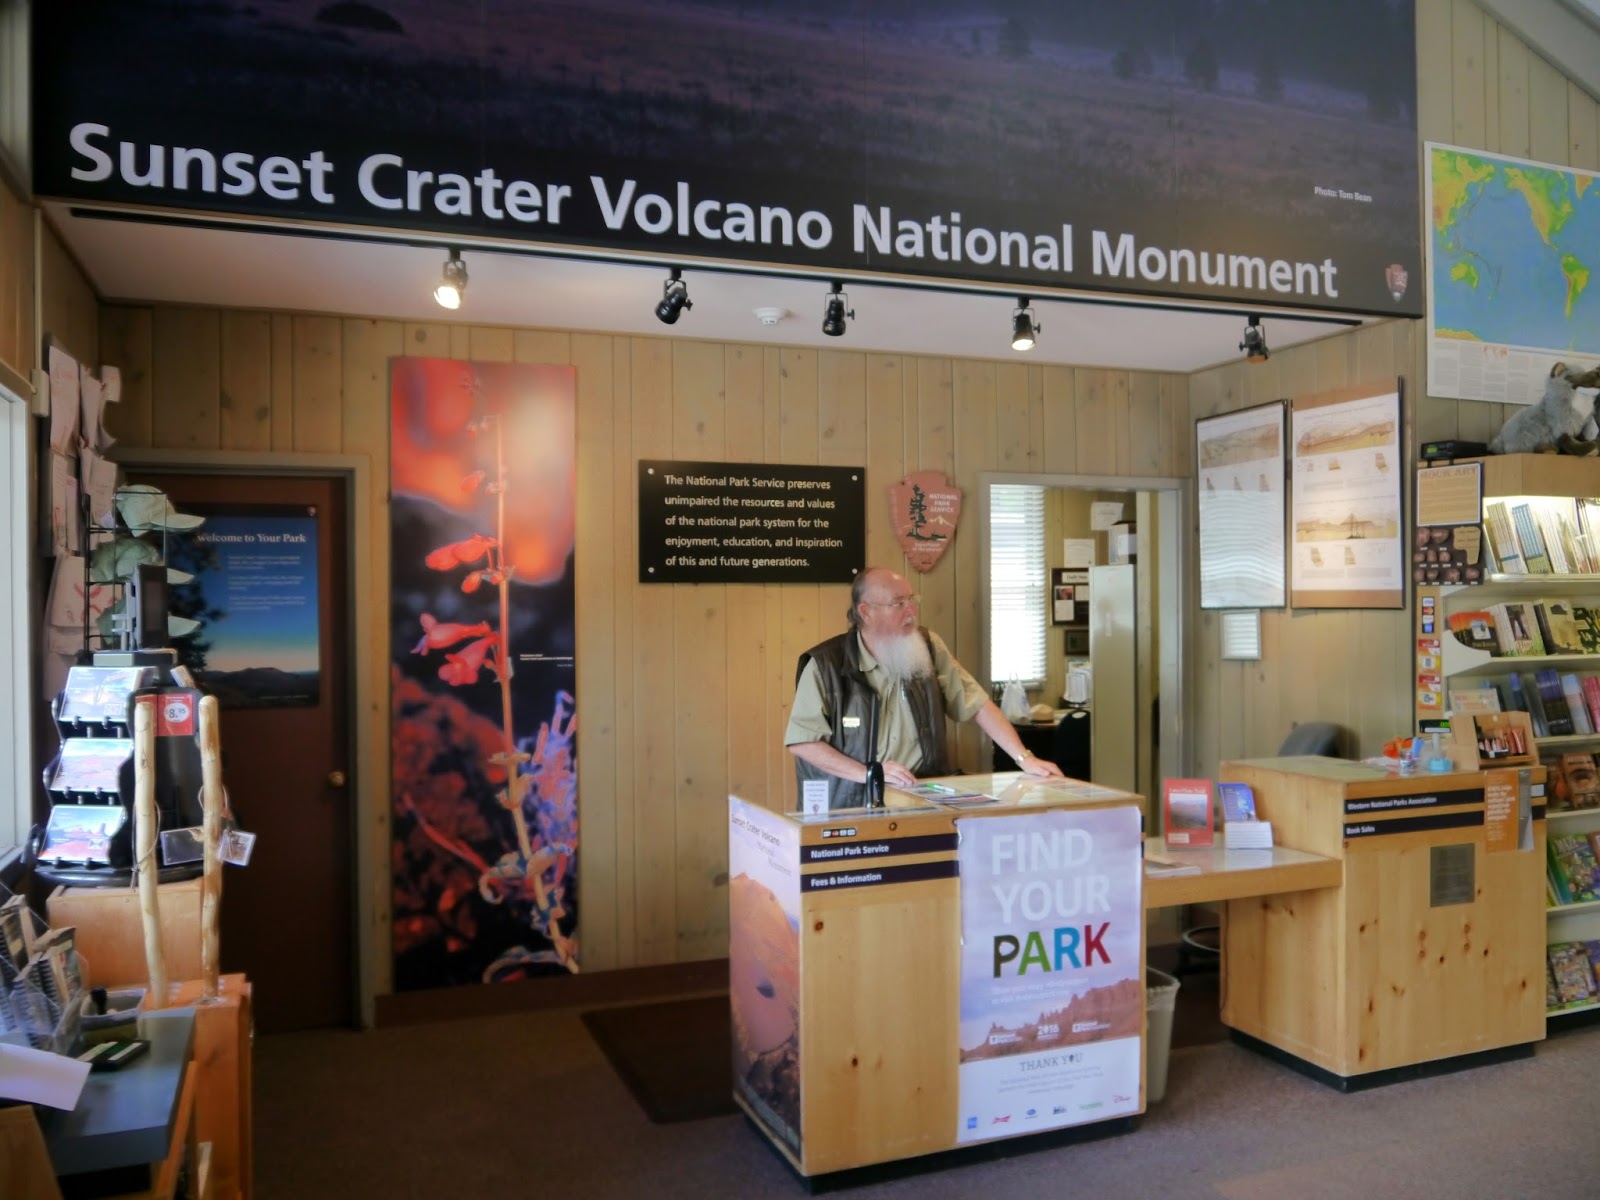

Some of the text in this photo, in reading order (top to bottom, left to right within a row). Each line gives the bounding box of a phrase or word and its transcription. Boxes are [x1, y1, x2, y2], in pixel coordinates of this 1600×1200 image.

[1314, 186, 1372, 202] Photo: Tom Bean
[69, 122, 1339, 298] Sunset Crater Volcano National Monument
[664, 475, 830, 490] The National Park Service preserves
[665, 495, 835, 508] unimpaired the resources and values
[928, 493, 958, 501] NATIONAL
[929, 506, 954, 514] SERVICE
[665, 515, 829, 529] of the national park system for the
[244, 534, 255, 543] to
[256, 533, 282, 543] Your
[283, 533, 307, 543] Park
[665, 536, 842, 548] enjoyment, education, and inspiration
[666, 556, 809, 568] of this and future generations.
[1347, 795, 1437, 811] Western National Parks Association
[1346, 825, 1375, 835] Book Sales
[810, 844, 889, 859] National Park Service
[991, 828, 1093, 875] FIND
[810, 872, 882, 887] Fees & Information
[991, 874, 1112, 925] YOUR
[993, 922, 1112, 979] PARK
[1019, 1056, 1059, 1072] THANK
